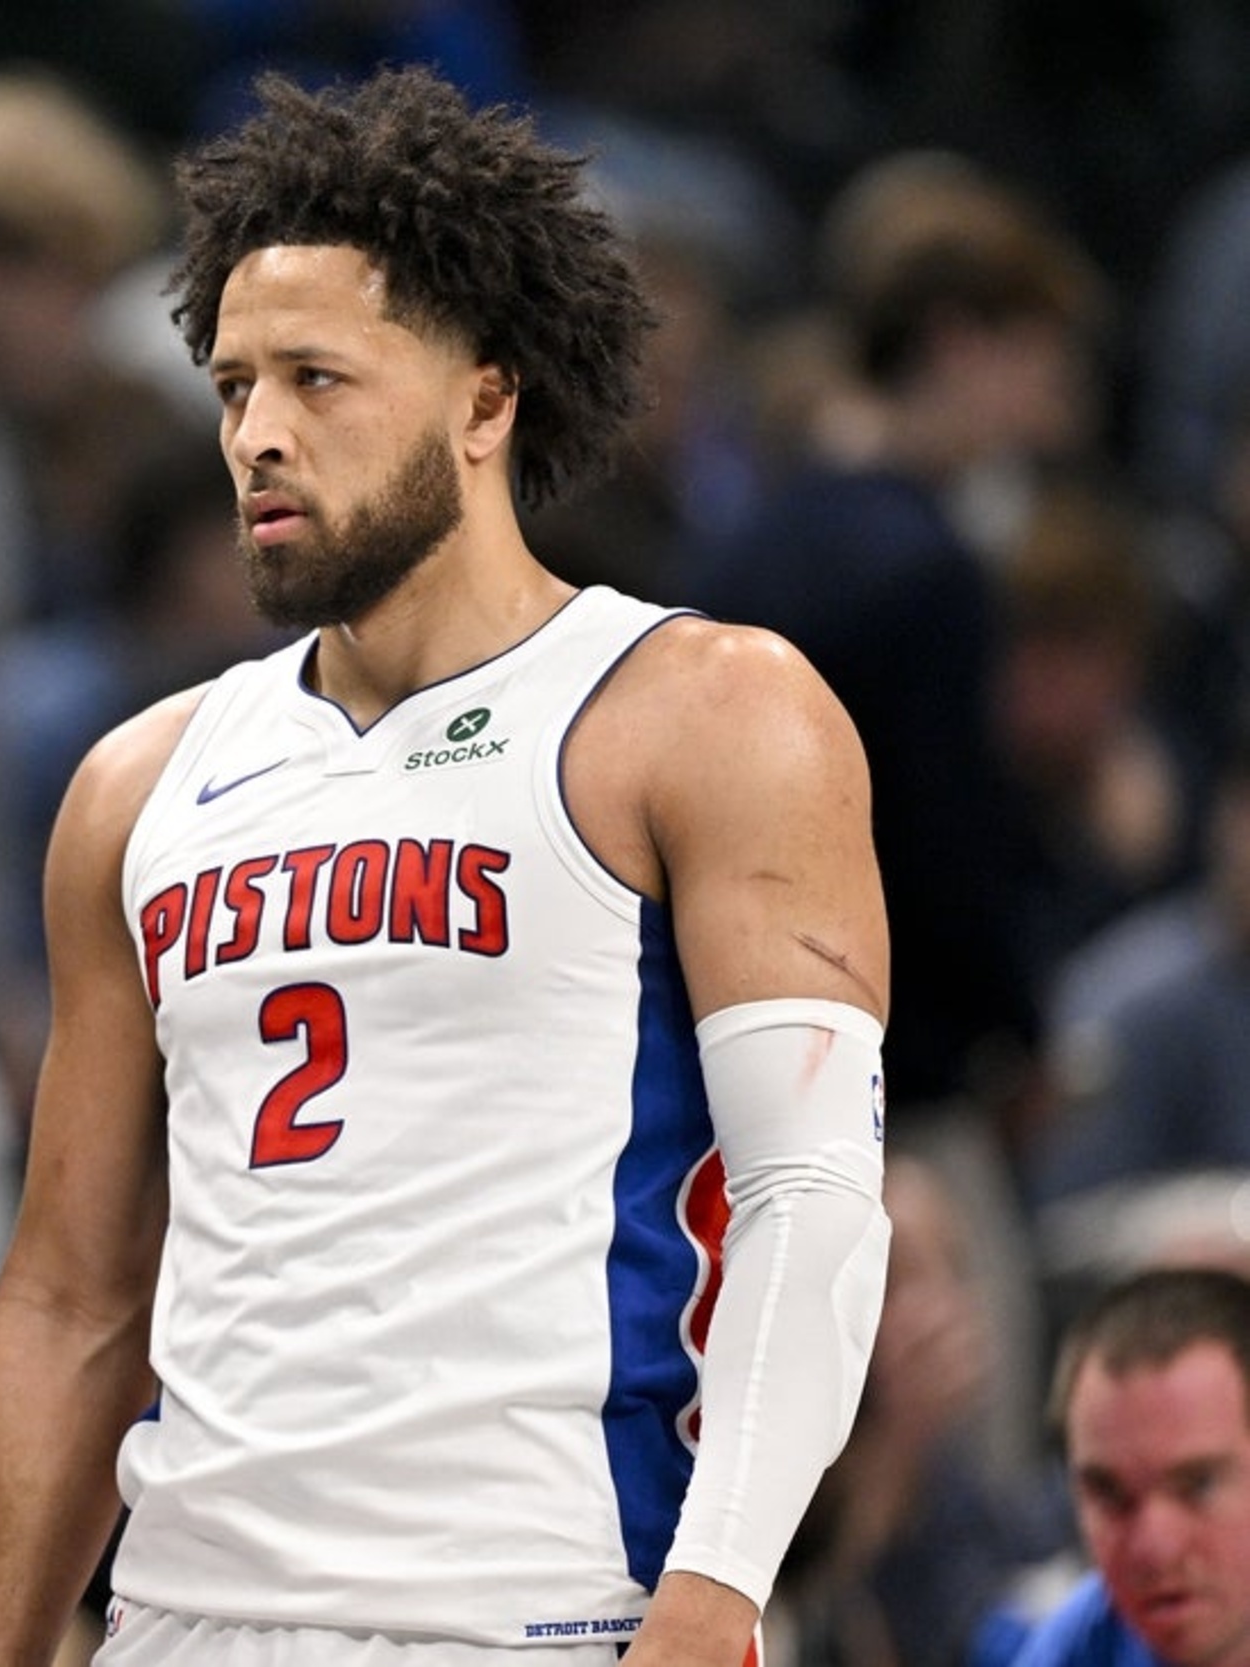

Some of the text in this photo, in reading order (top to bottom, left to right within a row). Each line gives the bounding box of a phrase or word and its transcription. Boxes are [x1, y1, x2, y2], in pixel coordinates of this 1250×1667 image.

[140, 837, 511, 1012] PISTONS
[250, 981, 348, 1169] 2
[525, 1621, 588, 1637] DETROIT
